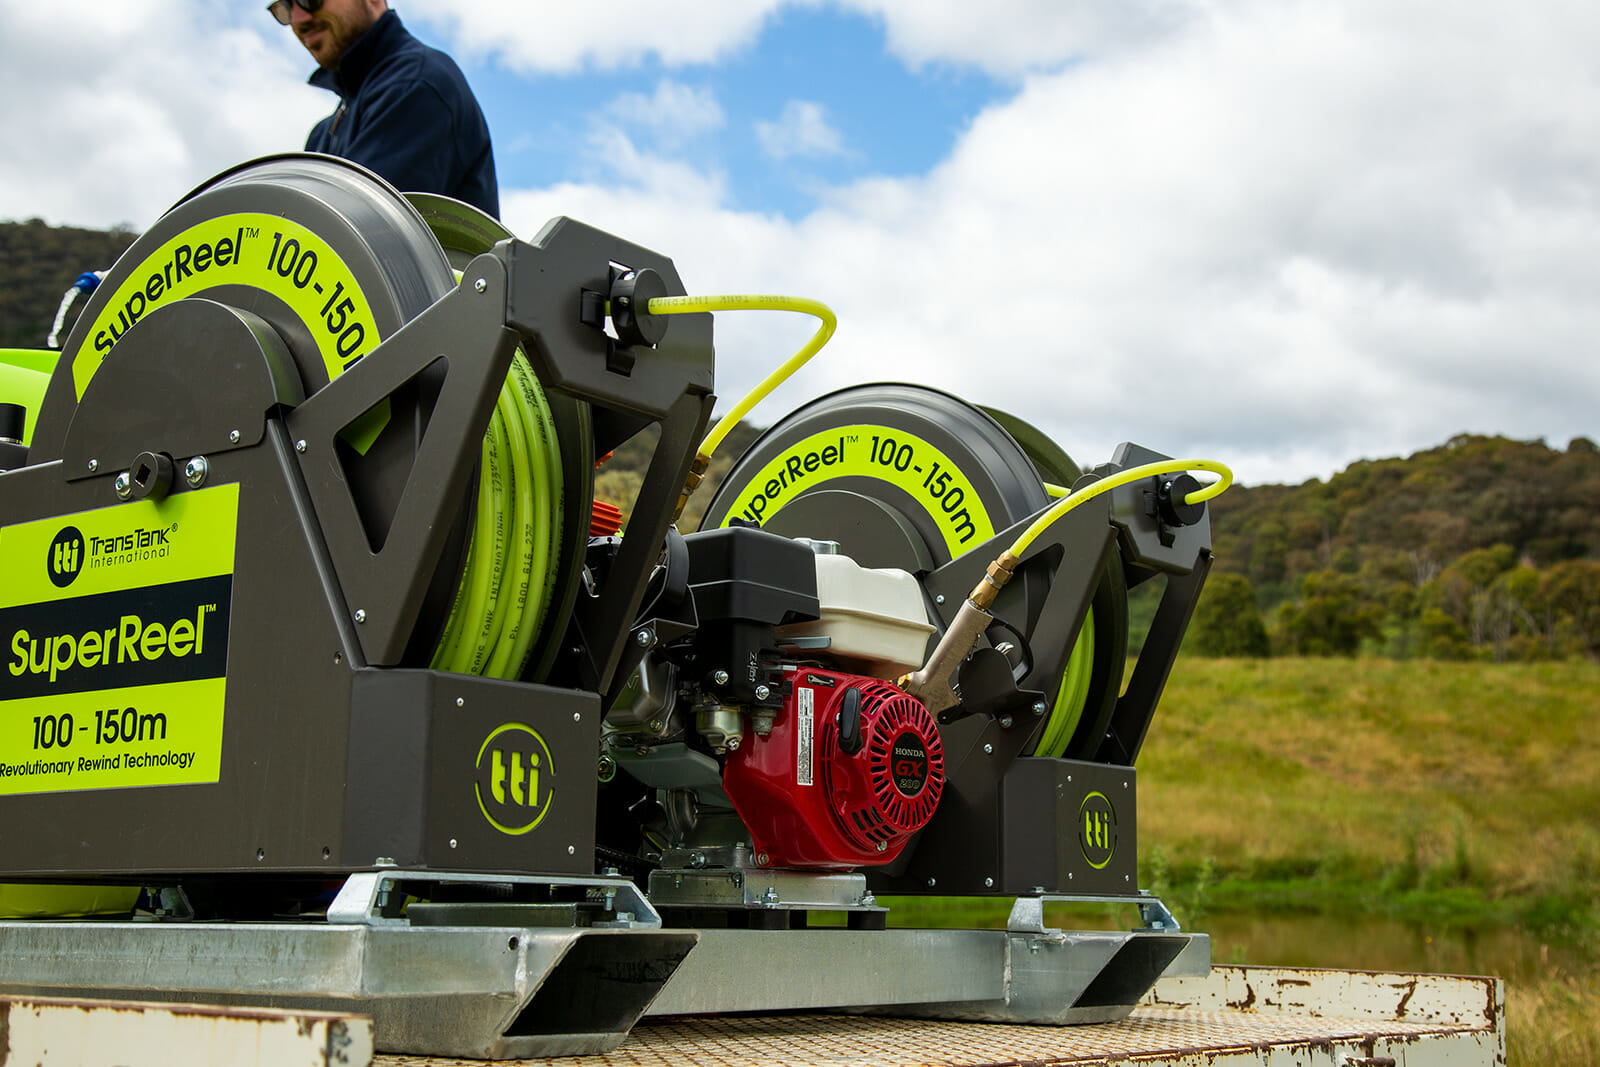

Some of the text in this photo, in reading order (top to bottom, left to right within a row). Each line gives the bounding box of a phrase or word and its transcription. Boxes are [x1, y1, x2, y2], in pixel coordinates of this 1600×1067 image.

[267, 232, 365, 372] 100-150
[90, 545, 170, 568] International
[0, 750, 196, 777] Revolutionary Rewind Technology
[895, 747, 925, 758] HONDA
[895, 760, 924, 778] GX
